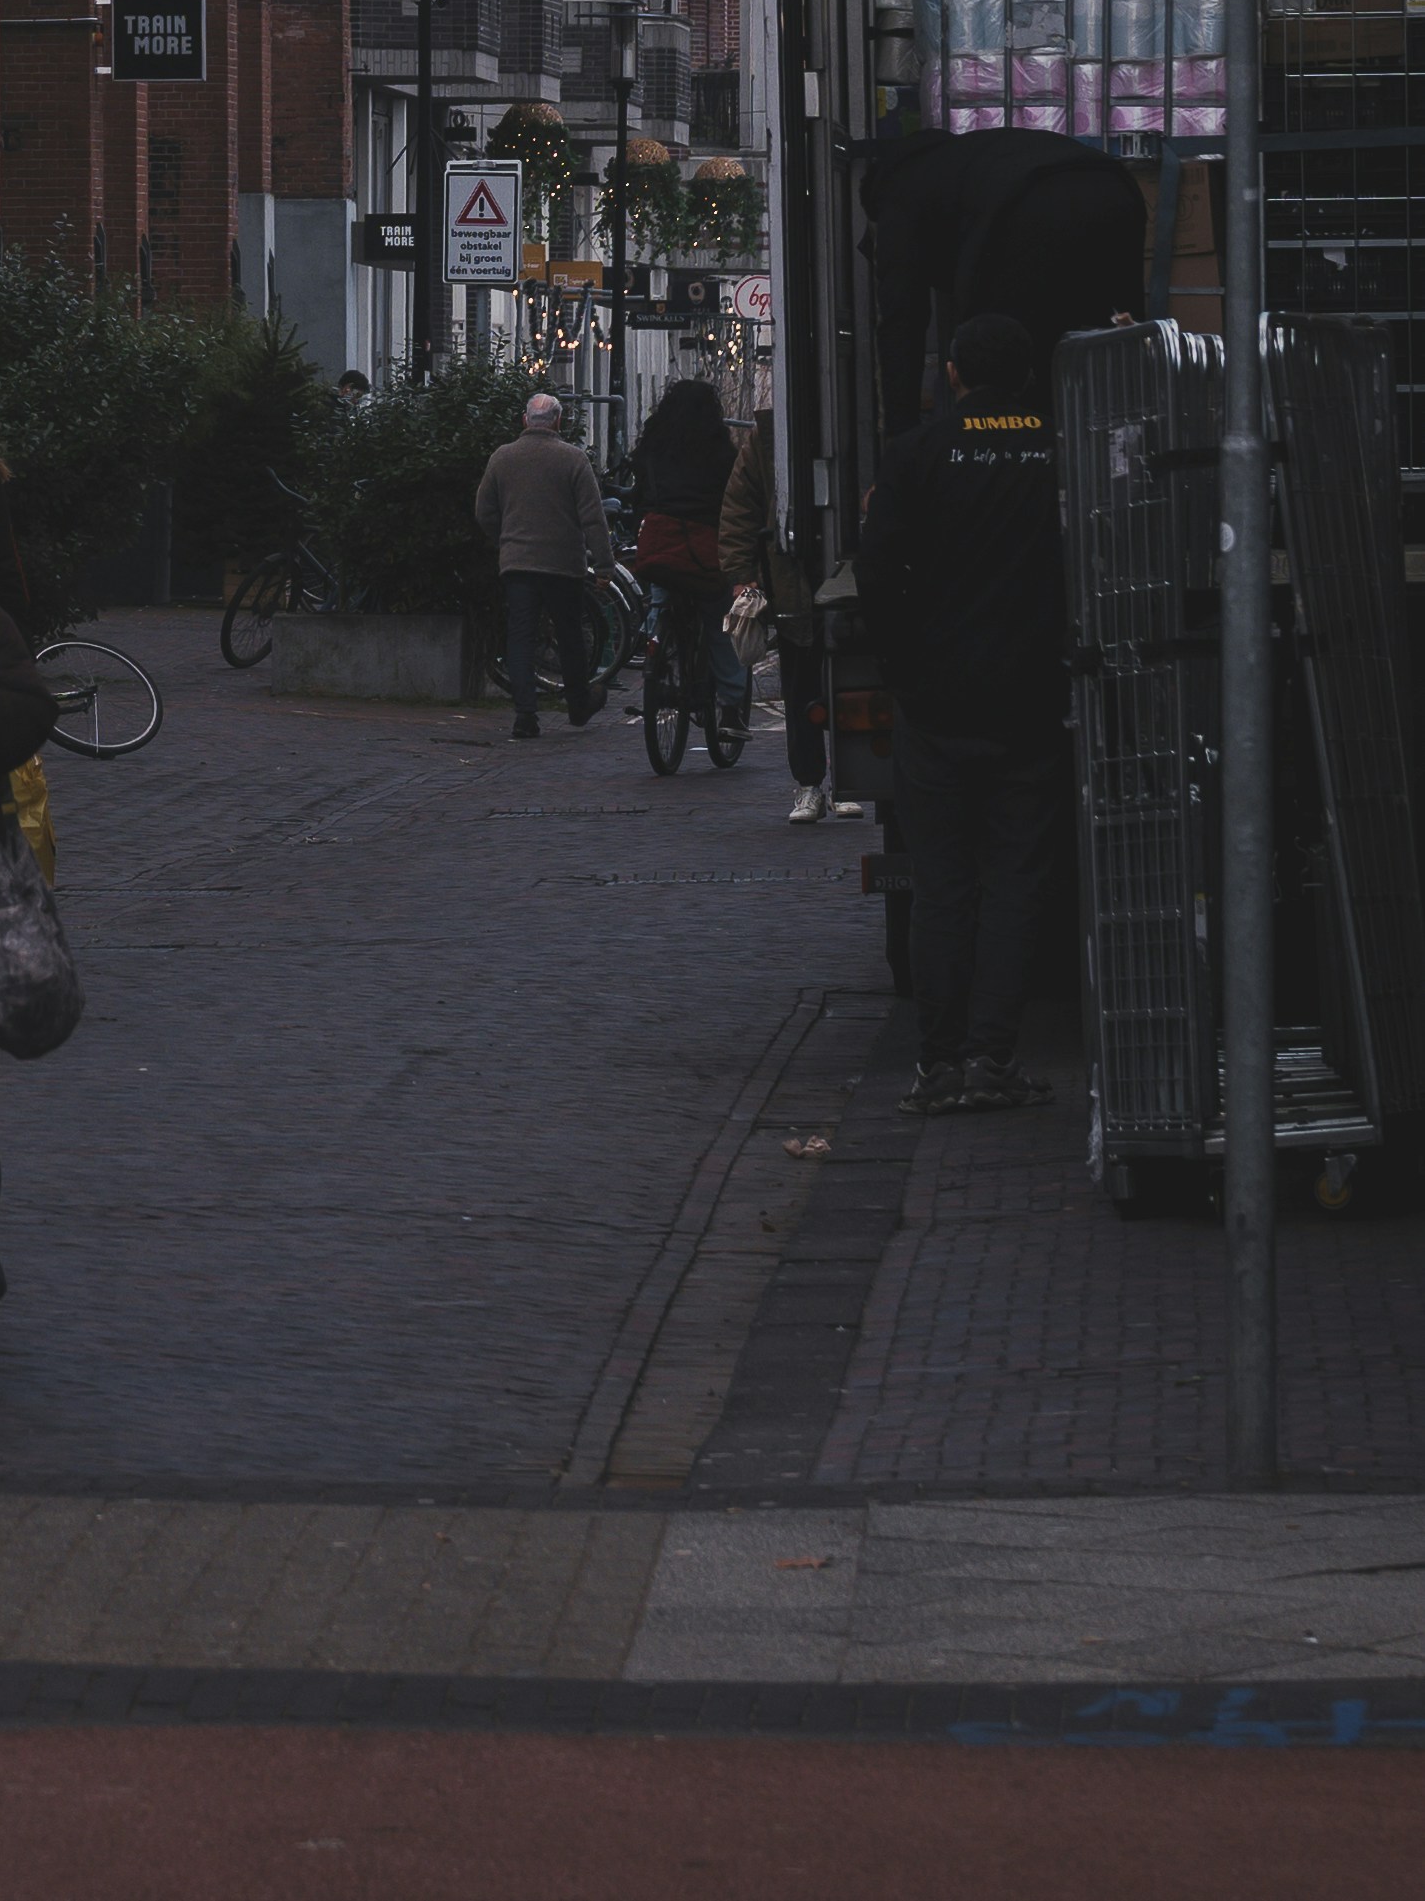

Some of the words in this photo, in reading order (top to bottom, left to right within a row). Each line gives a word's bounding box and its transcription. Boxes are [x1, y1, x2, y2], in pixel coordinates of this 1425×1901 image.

[123, 14, 187, 35] TRAIN
[134, 35, 193, 55] MORE
[380, 226, 412, 236] TRAIN
[451, 229, 512, 240] beweegbaar
[385, 236, 415, 247] MORE
[460, 241, 502, 251] obstakel
[459, 253, 471, 265] bij
[474, 255, 503, 265] groen
[449, 267, 468, 275] één
[470, 267, 512, 277] voertuig
[962, 416, 1042, 430] JUMBO
[949, 448, 965, 462] Ik
[973, 447, 997, 466] help
